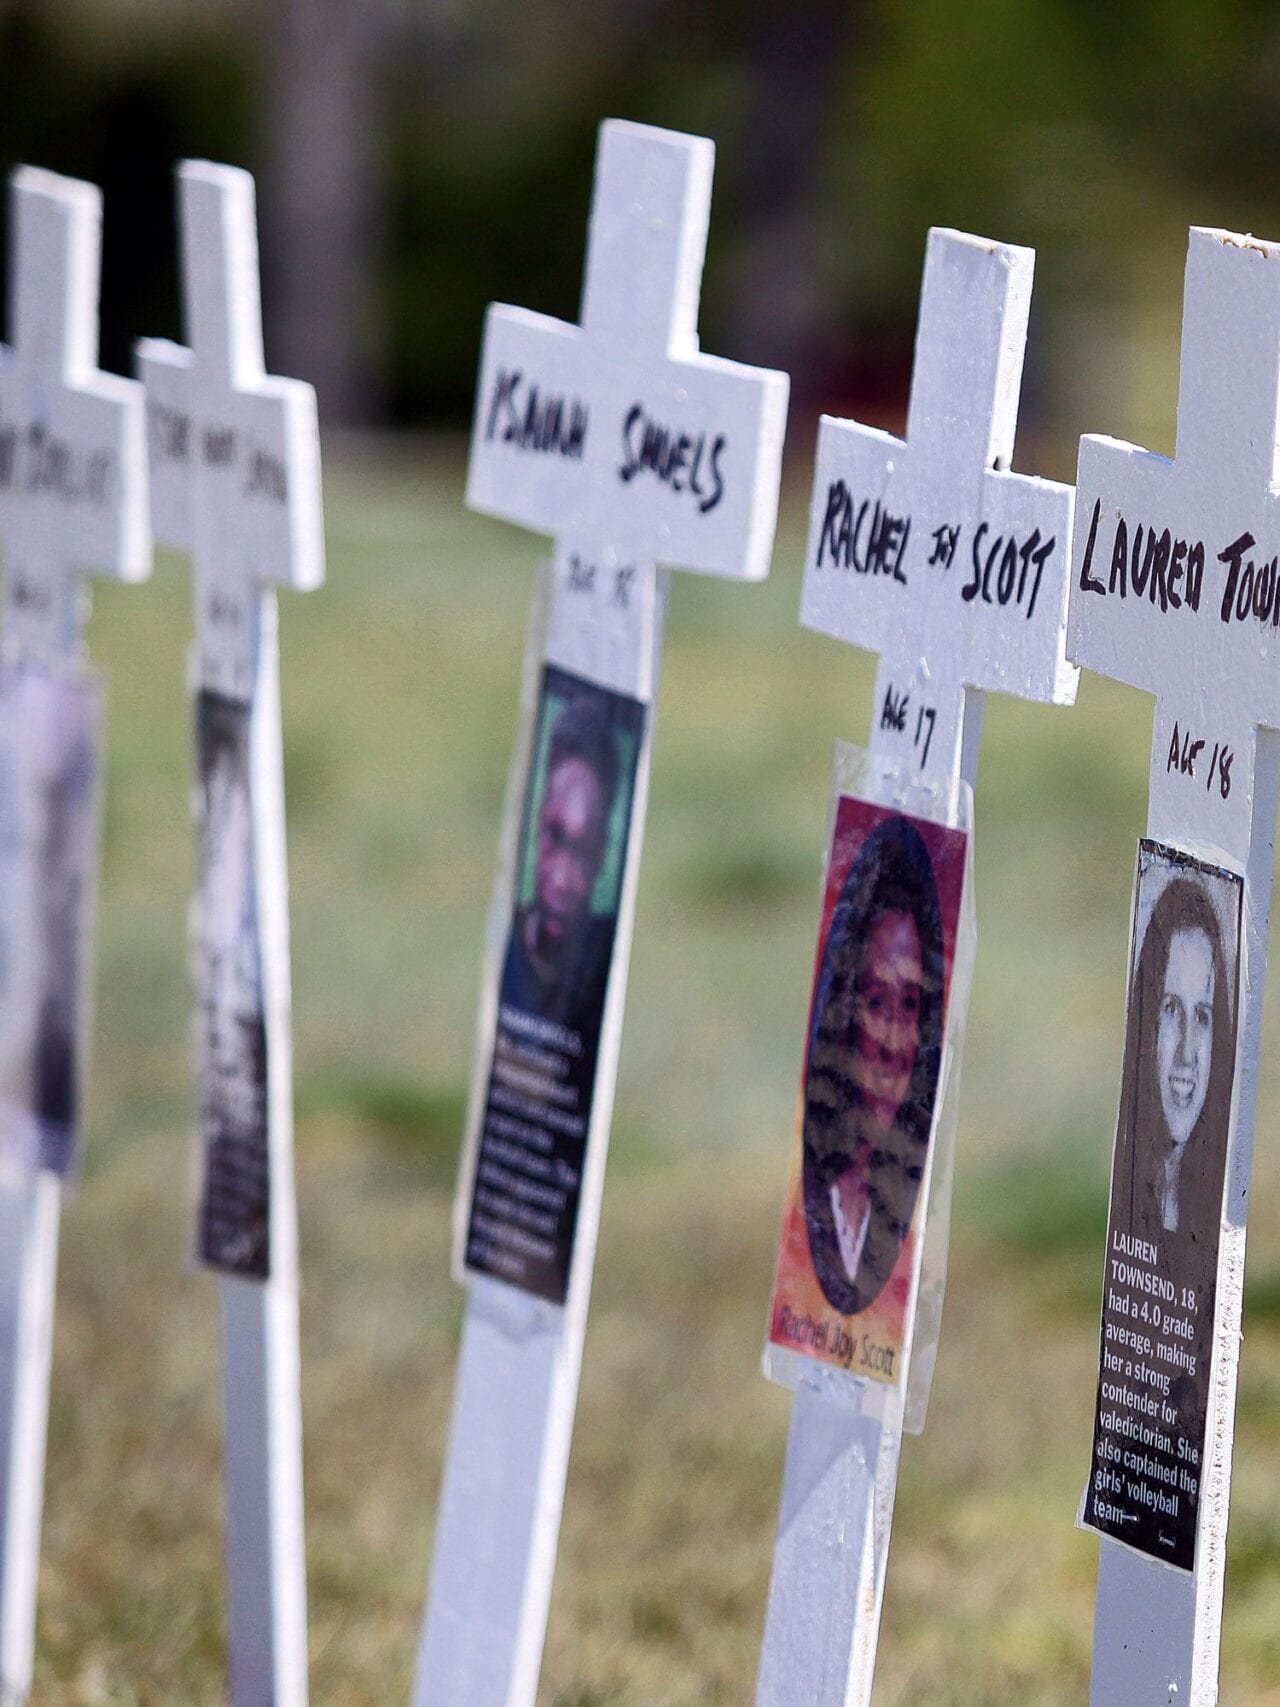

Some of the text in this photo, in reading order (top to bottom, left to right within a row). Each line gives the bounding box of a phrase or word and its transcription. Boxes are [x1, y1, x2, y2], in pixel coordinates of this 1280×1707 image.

[816, 478, 911, 585] RACHEL
[961, 522, 1056, 620] SCOTT
[1079, 497, 1205, 614] LAUREN
[880, 683, 937, 771] AGE 17
[1167, 721, 1234, 799] AGE 18
[1113, 1230, 1158, 1265] LAUREN
[1108, 1288, 1195, 1340] had a 4.0 grade
[1111, 1260, 1199, 1315] TOWNSEND, 18,
[780, 1304, 895, 1377] Rachel Joy Scott
[1106, 1322, 1197, 1376] average, making
[1104, 1347, 1171, 1397] her a strong
[1102, 1382, 1178, 1425] contender for
[1100, 1410, 1199, 1464] valedictorian. She
[1097, 1438, 1198, 1494] also captained the
[1095, 1470, 1179, 1518] girls' volleyball
